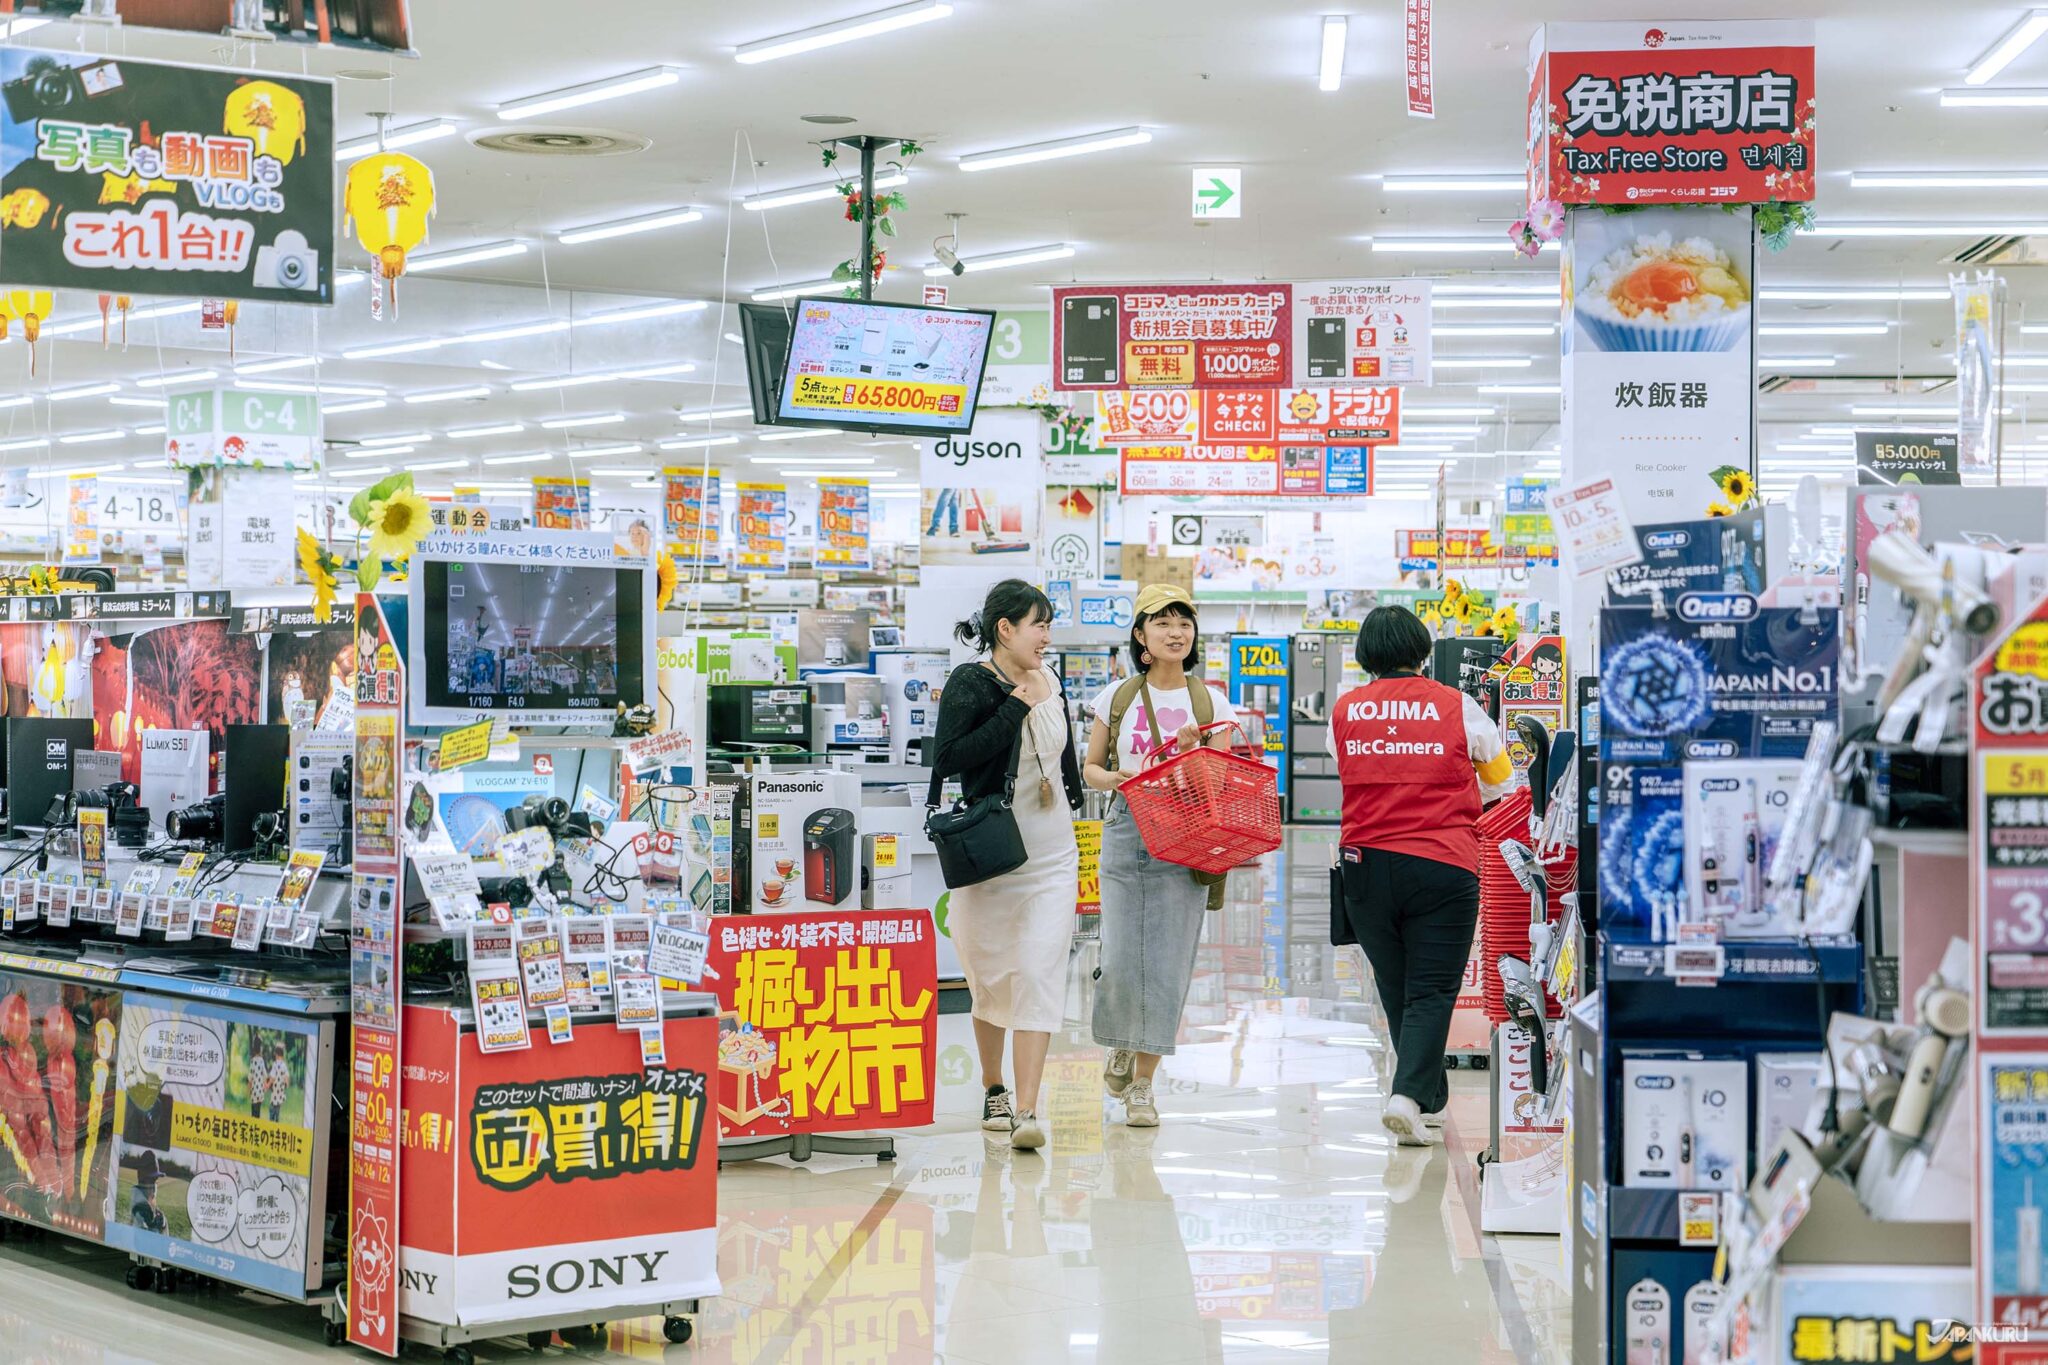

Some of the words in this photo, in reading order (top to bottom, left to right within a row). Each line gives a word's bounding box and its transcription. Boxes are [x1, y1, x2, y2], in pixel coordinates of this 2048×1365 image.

[1566, 73, 1793, 132] 免税商店
[41, 123, 280, 184] 写真も動画も
[1563, 149, 1602, 170] Tax
[1609, 148, 1657, 169] Free
[1664, 146, 1723, 169] Store
[1741, 146, 1803, 169] 면세점
[199, 181, 281, 209] VLOGも
[1670, 187, 1706, 196] くらし応援
[1709, 186, 1738, 196] コジマ
[74, 210, 245, 262] これ1台!!
[1329, 286, 1391, 295] コジマでつかえば
[1300, 295, 1422, 306] 一度のお買い物でポイントが
[1314, 305, 1371, 315] 両方たまる!
[1133, 319, 1276, 338] 新規会員募集中!
[1135, 346, 1157, 354] 入会金
[1139, 357, 1181, 375] 無料
[1202, 354, 1251, 373] 1,000
[1251, 358, 1278, 366] ポイント
[800, 377, 841, 393] 5点セット
[857, 385, 937, 411] 65,800円
[1216, 392, 1264, 402] クーポンを
[1615, 381, 1708, 408] 炊飯器
[176, 397, 203, 431] C-4
[243, 396, 296, 431] C-4
[1130, 392, 1188, 421] 500
[1216, 404, 1263, 417] 今すぐ
[1333, 395, 1392, 416] アプリ
[1214, 420, 1266, 432] CHECK!
[1338, 415, 1386, 427] で配信中!
[934, 435, 1021, 467] dyson
[1635, 463, 1653, 472] Rice
[1656, 463, 1687, 472] Cooker
[1871, 459, 1947, 471] キャッシュバック!
[247, 517, 270, 529] 電球
[241, 531, 276, 544] 蛍光灯
[1648, 532, 1687, 547] Oral-B
[141, 599, 171, 611] ミラーレス
[1682, 598, 1752, 618] Oral-B
[1239, 646, 1282, 666] 170L
[1705, 675, 1769, 692] JAPAN
[1772, 666, 1832, 692] No.1
[468, 697, 493, 707] 1/160
[508, 697, 525, 707] F4.0
[568, 698, 580, 707] ISO
[580, 698, 600, 707] AUTO
[1133, 705, 1149, 732] I
[1347, 700, 1441, 722] KOJIMA
[47, 741, 66, 753] OM
[145, 737, 170, 750] LUMIX
[1345, 739, 1444, 756] BicCamera
[1688, 743, 1733, 757] Oral-B
[47, 762, 67, 770] OM-1
[521, 777, 548, 785] ZV-E10
[758, 780, 824, 793] Panasonic
[1702, 779, 1739, 791] Oral-B
[1765, 790, 1788, 807] iO
[721, 919, 923, 952] 色褪せ・外装不良・開梱品!
[734, 946, 933, 1029] 掘り出し
[158, 1030, 203, 1045] 写真だけじゃない!
[778, 1022, 926, 1118] 物市
[644, 1069, 705, 1096] オススメ
[479, 1080, 637, 1106] このセットで間違いナシ!
[175, 1112, 303, 1155] いつもの毎日を家族の特別に
[244, 1211, 291, 1225] しっかりピントが合う
[507, 1250, 670, 1299] SONY
